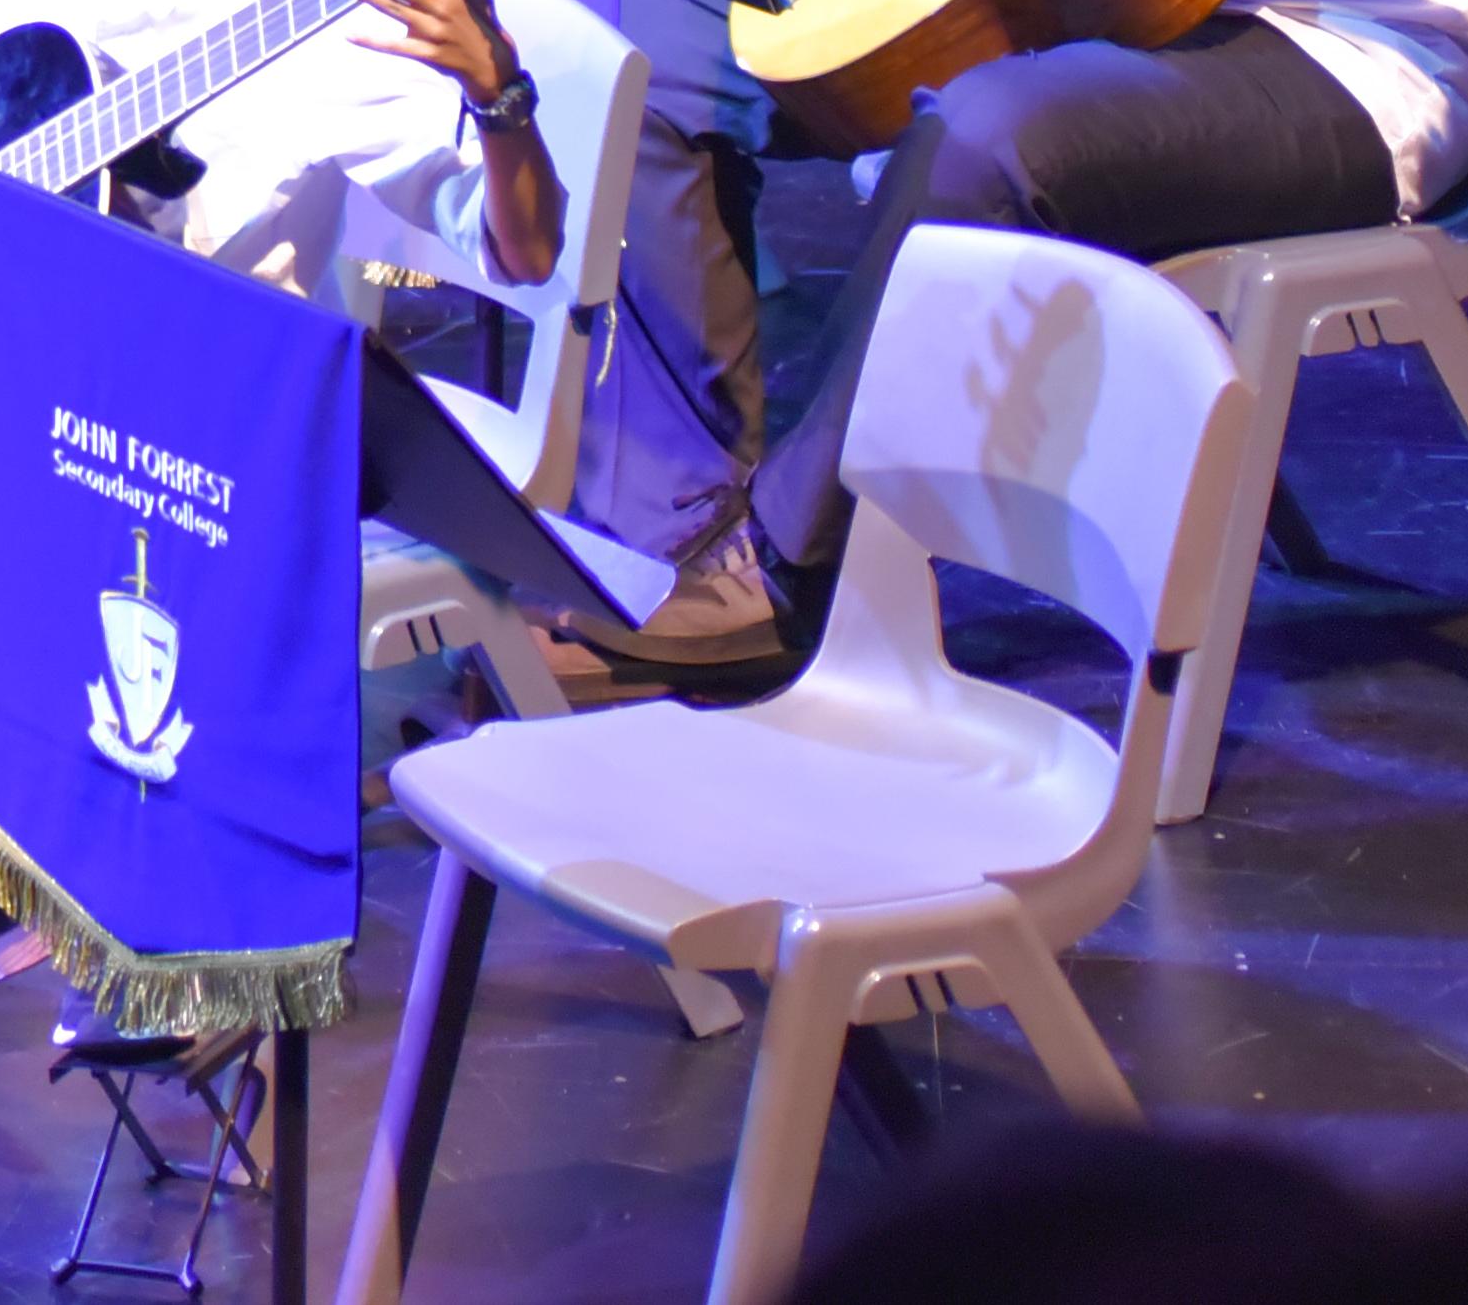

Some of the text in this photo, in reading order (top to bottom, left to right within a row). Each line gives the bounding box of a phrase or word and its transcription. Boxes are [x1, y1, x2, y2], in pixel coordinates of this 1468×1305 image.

[50, 406, 236, 513] JOHN FORREST
[52, 448, 229, 549] Secondary College
